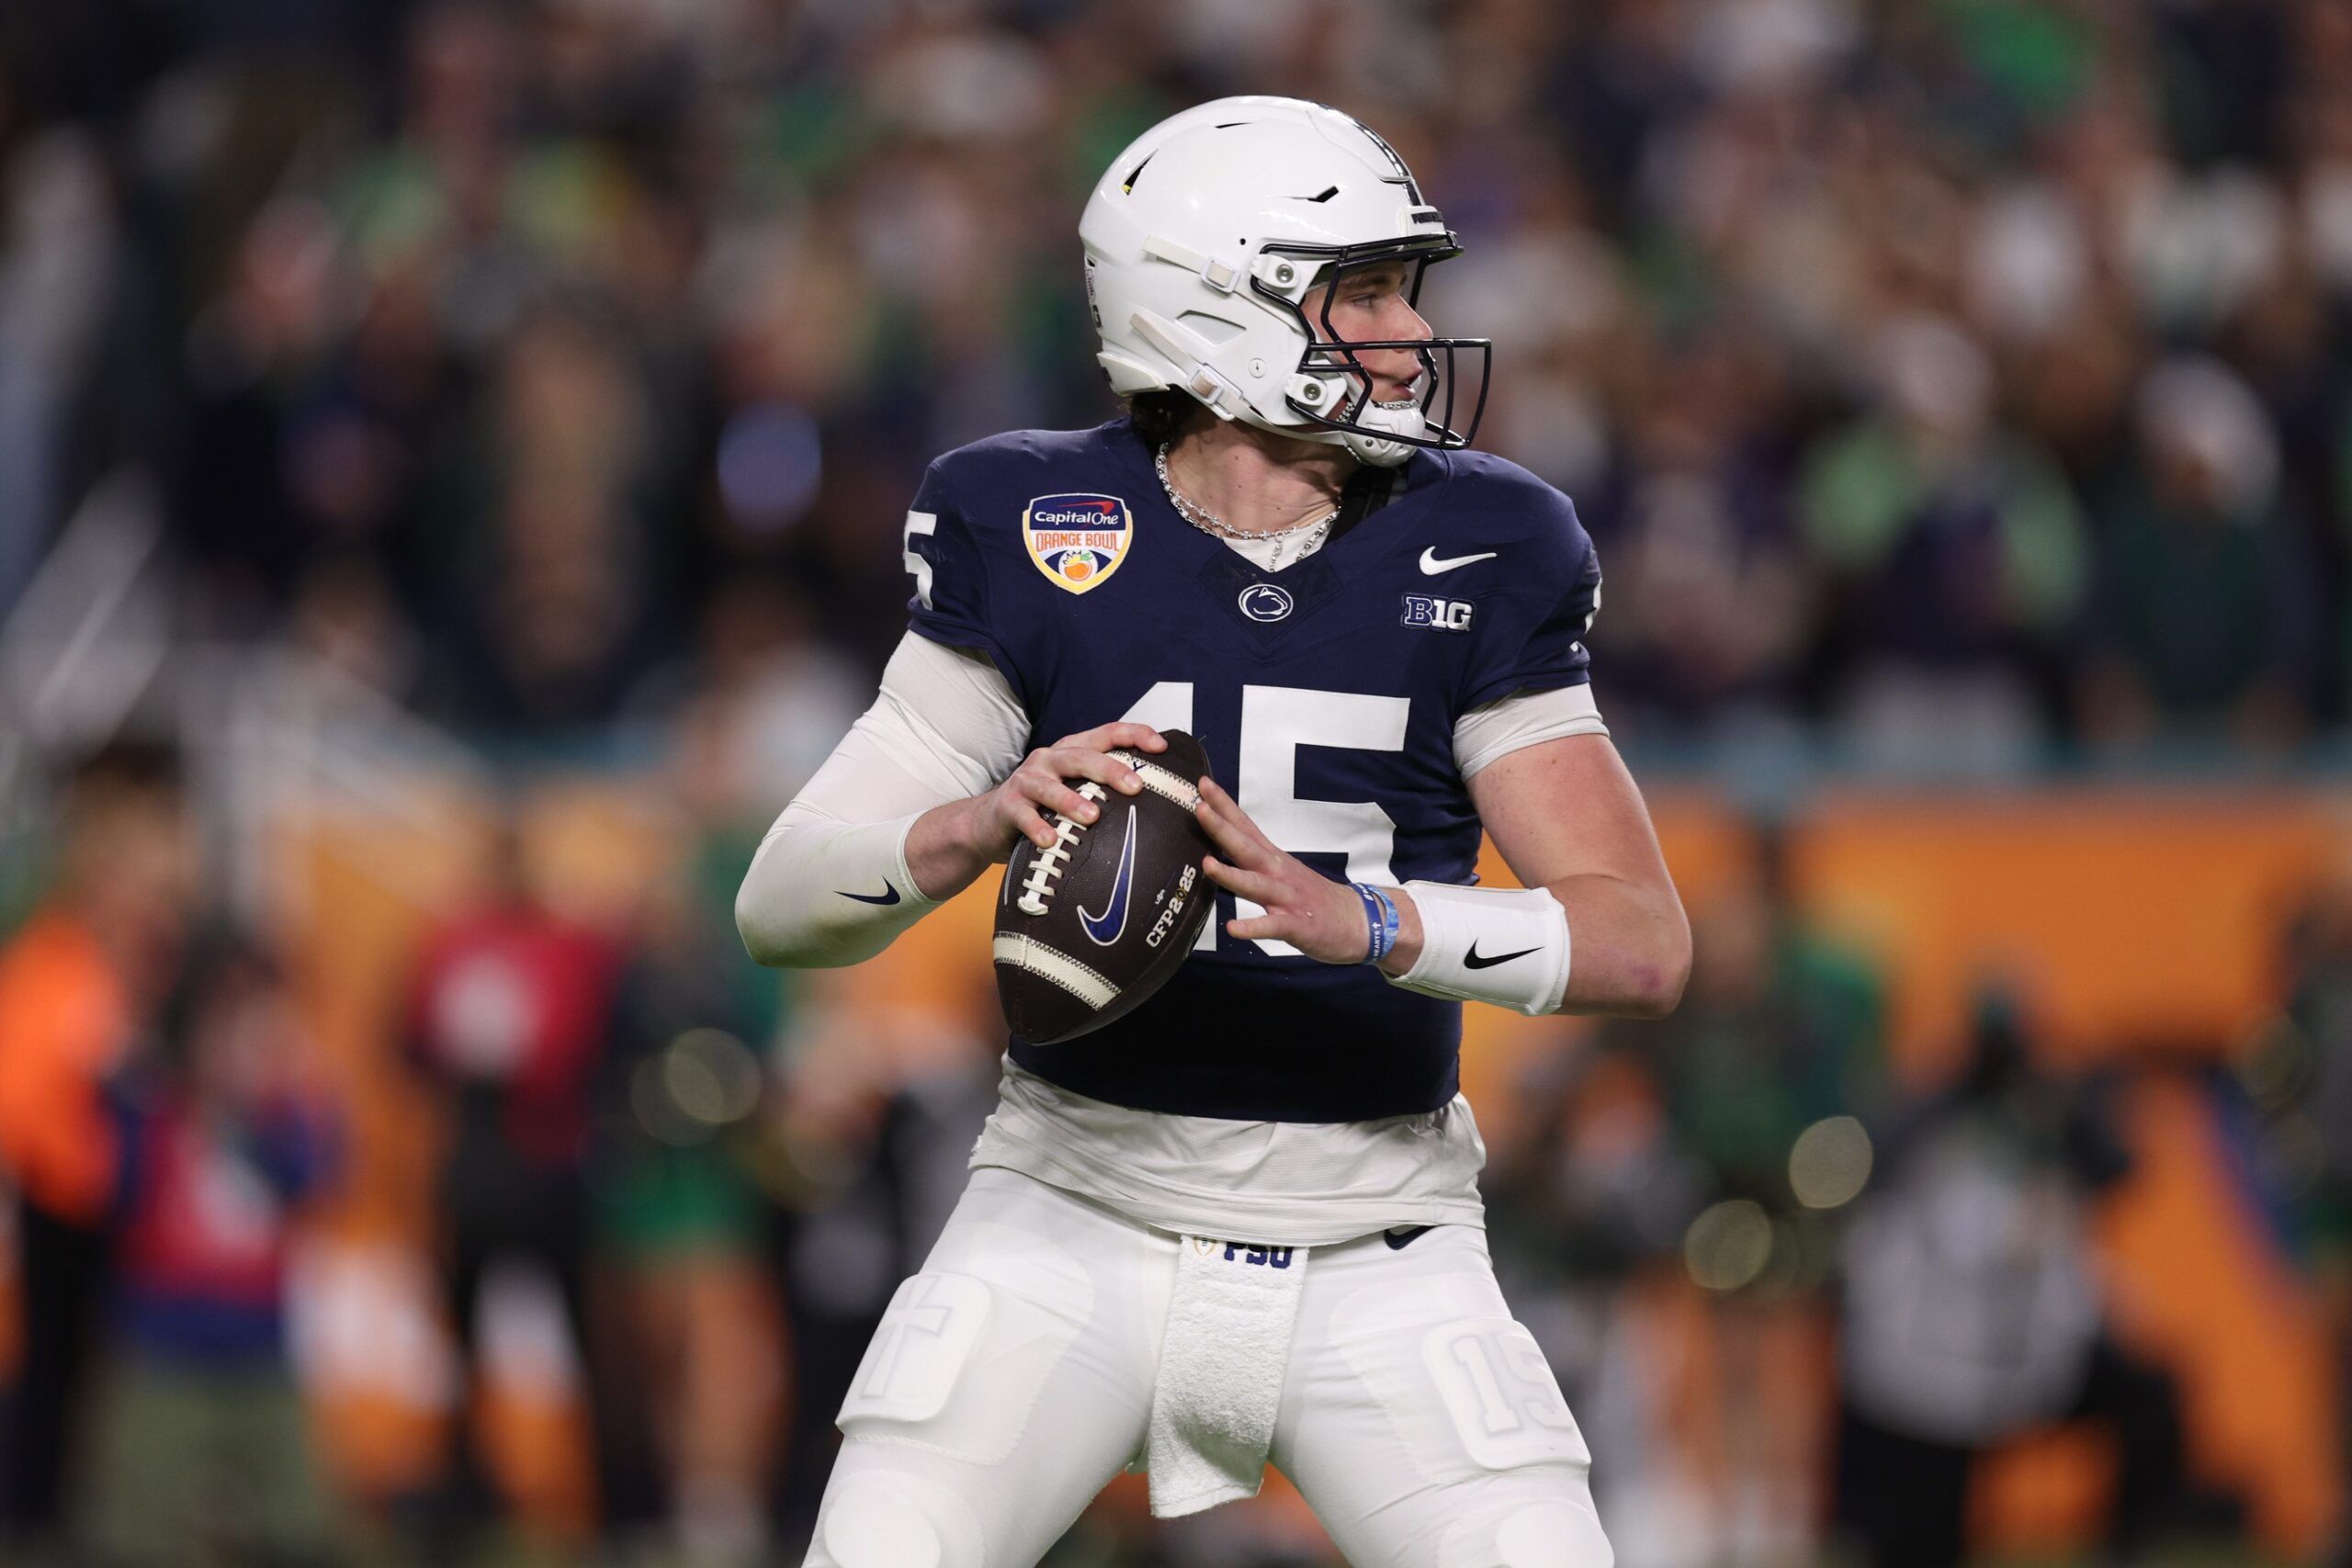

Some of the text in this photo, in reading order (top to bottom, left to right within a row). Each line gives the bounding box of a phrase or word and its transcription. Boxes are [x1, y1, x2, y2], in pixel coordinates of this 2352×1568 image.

[1035, 532, 1120, 552] ORANGE BOWL
[1451, 1332, 1574, 1434] 15
